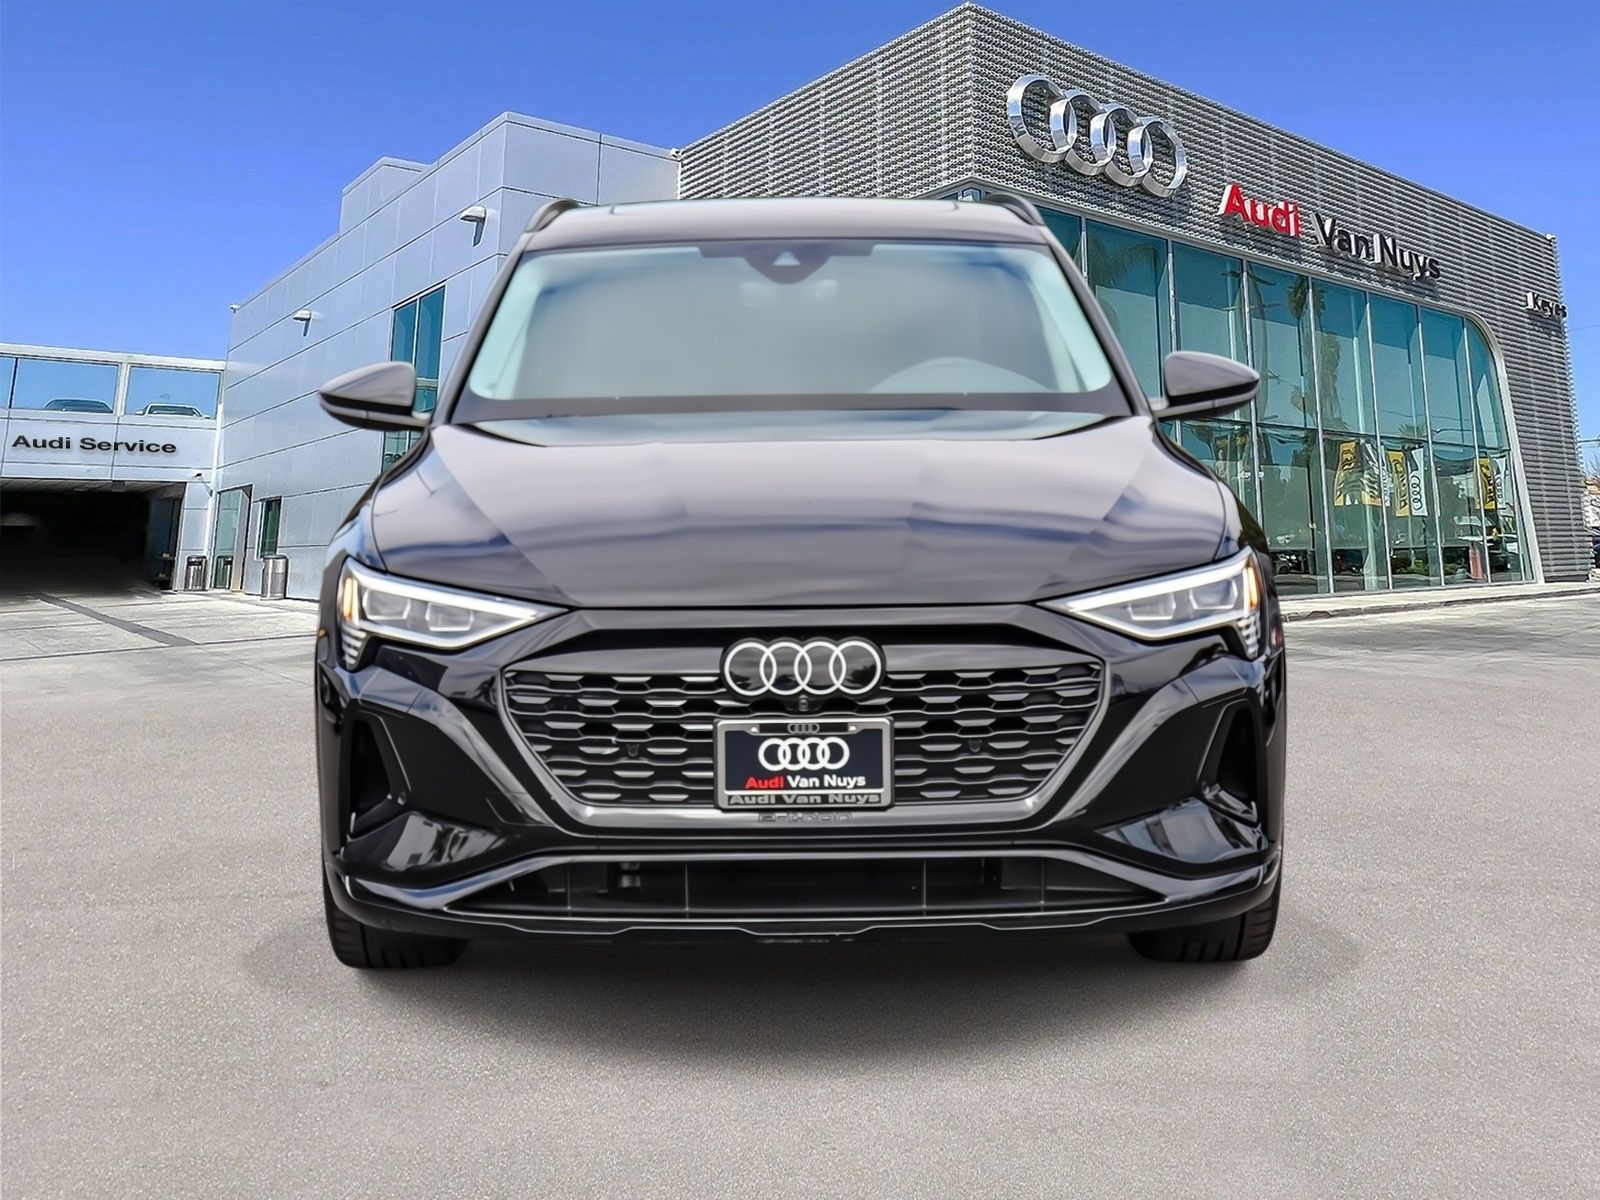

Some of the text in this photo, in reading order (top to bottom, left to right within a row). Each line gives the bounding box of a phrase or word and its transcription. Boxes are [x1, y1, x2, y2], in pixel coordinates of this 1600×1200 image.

[1220, 183, 1442, 281] Audi Van Nuys
[1527, 292, 1567, 319] Keyes
[12, 434, 177, 453] Audi Service
[745, 773, 866, 789] Audi Van Nuys
[729, 792, 880, 805] Audi Van Nuys
